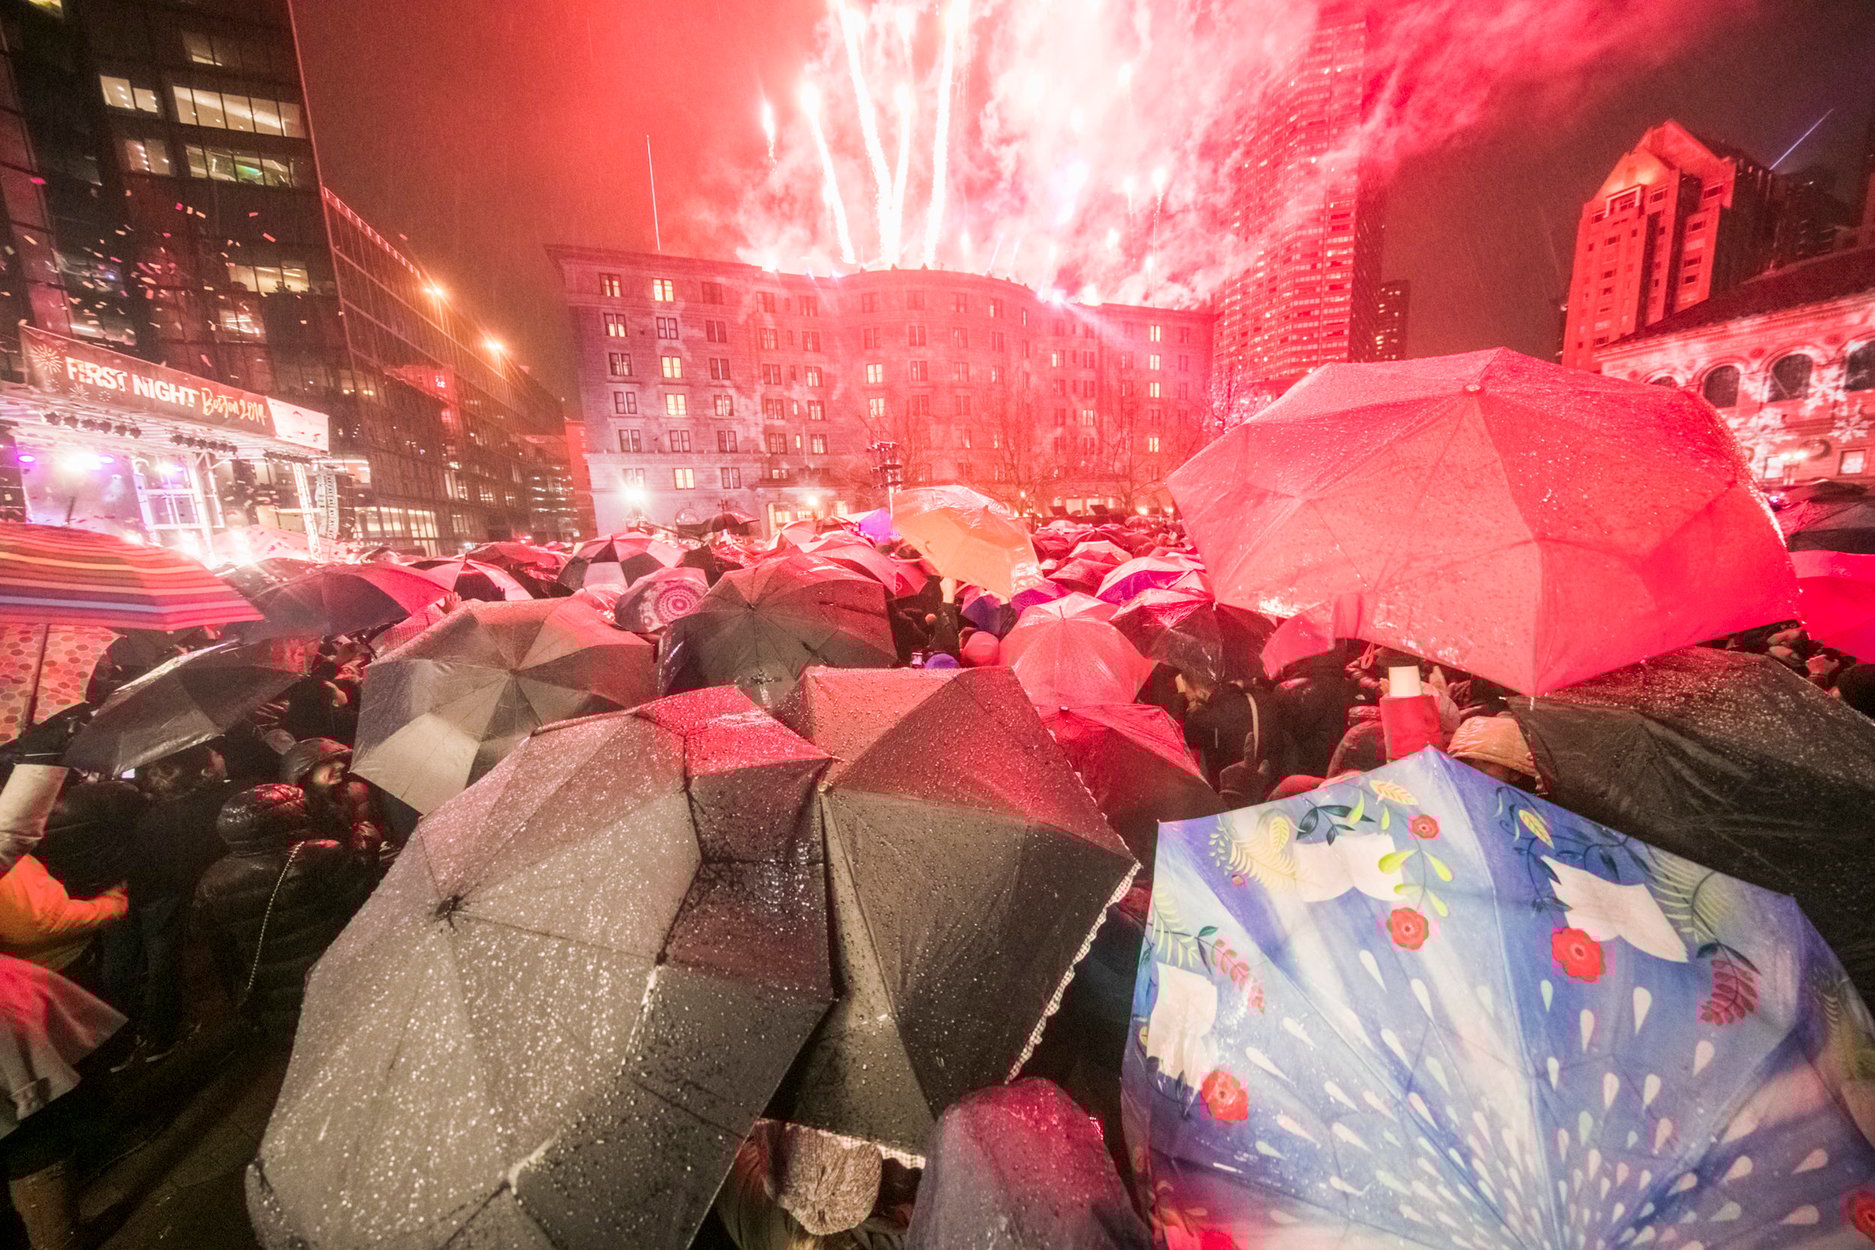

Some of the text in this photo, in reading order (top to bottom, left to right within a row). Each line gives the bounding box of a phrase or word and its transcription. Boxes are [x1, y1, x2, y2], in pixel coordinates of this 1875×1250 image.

[65, 356, 128, 392] FIRST
[132, 373, 200, 408] NIGHT
[201, 387, 239, 418] Boston
